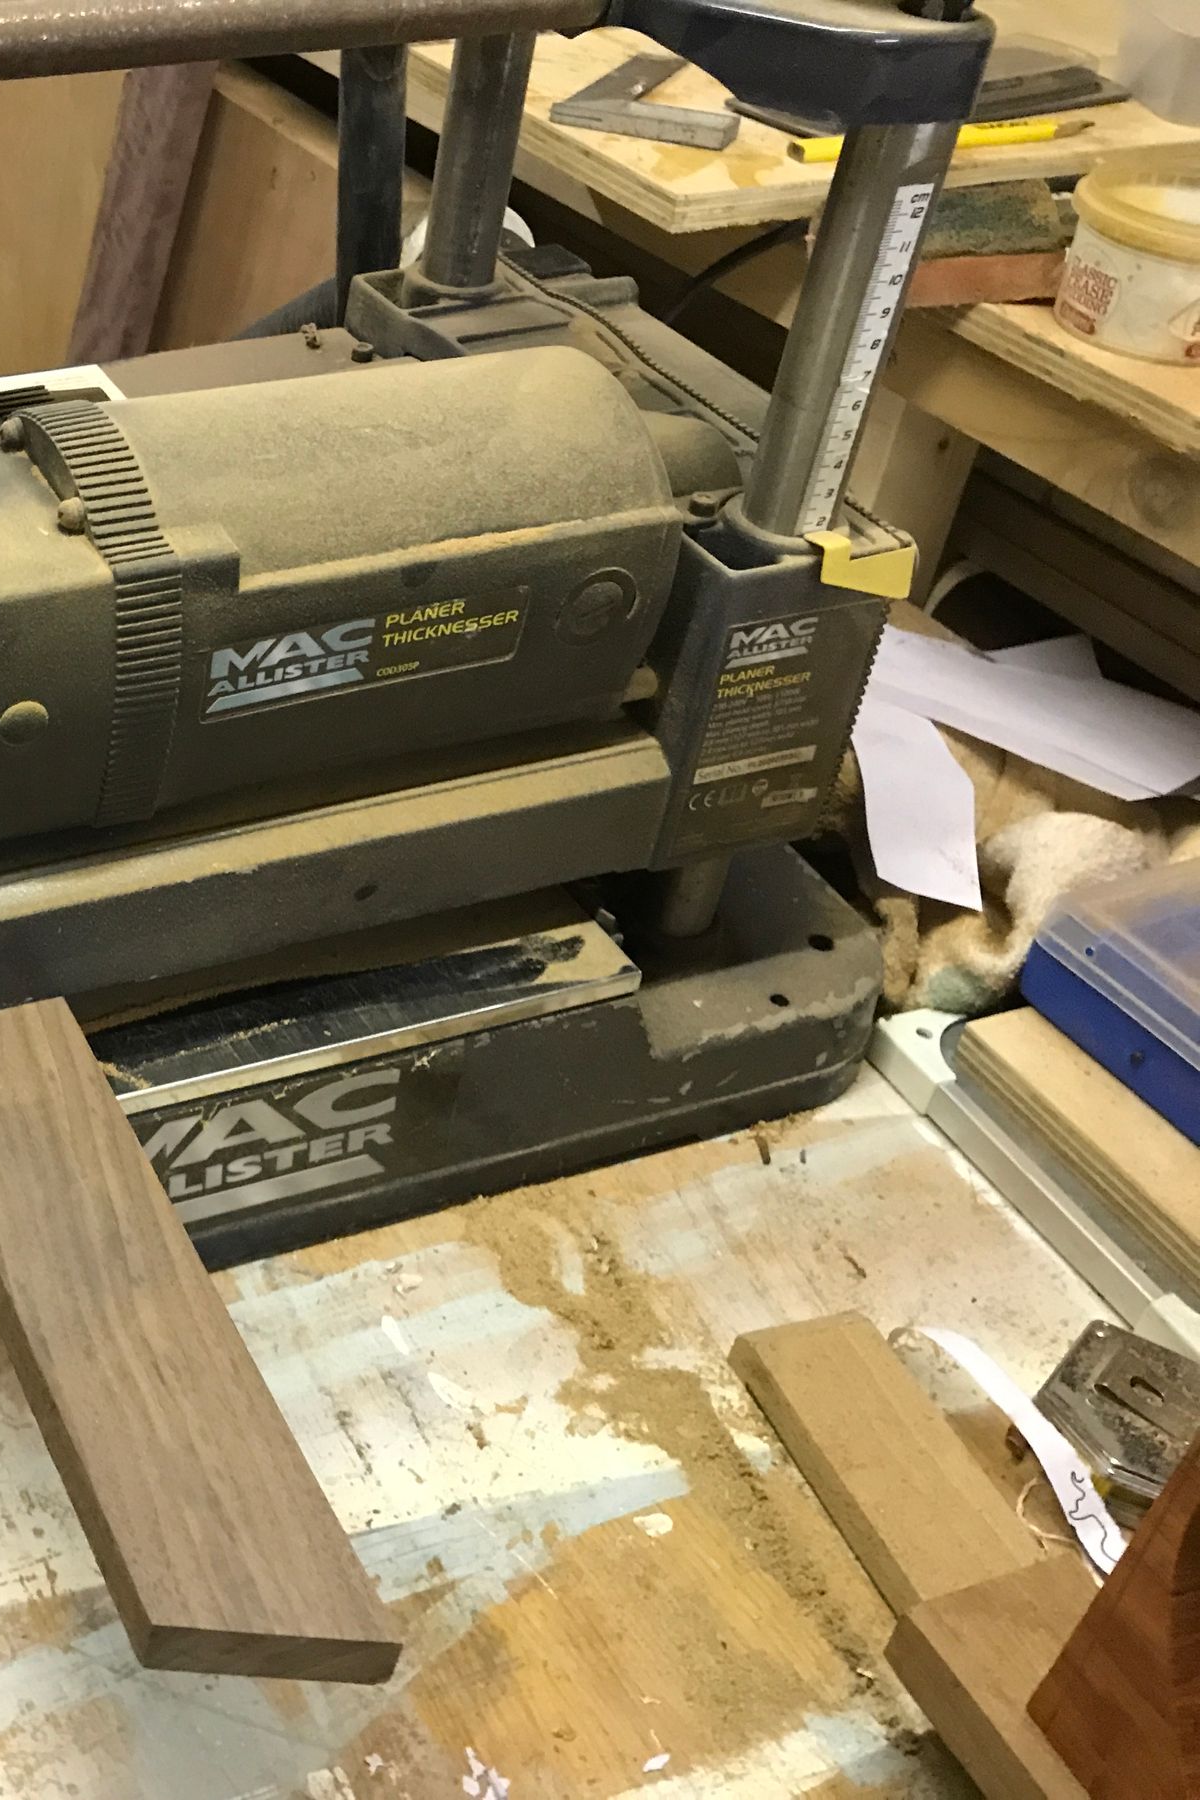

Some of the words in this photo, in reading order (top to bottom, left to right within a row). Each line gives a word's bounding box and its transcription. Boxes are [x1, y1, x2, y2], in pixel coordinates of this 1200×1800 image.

[911, 193, 929, 203] cm
[910, 207, 924, 219] 12
[888, 274, 903, 286] 10
[880, 307, 891, 318] 9
[870, 339, 881, 350] 8
[862, 371, 871, 381] 7
[852, 400, 862, 411] 6
[842, 430, 852, 440] 5
[834, 460, 843, 469] 4
[824, 488, 834, 498] 3
[816, 517, 826, 527] 2
[386, 601, 466, 629] PLANER
[382, 610, 519, 647] THICKNESSER
[730, 617, 819, 649] MAC
[210, 618, 376, 679] MAC
[726, 635, 813, 659] ALLISTER
[207, 650, 370, 697] ALLISTER
[720, 665, 775, 685] PLANER
[717, 672, 811, 698] THICKNESSER
